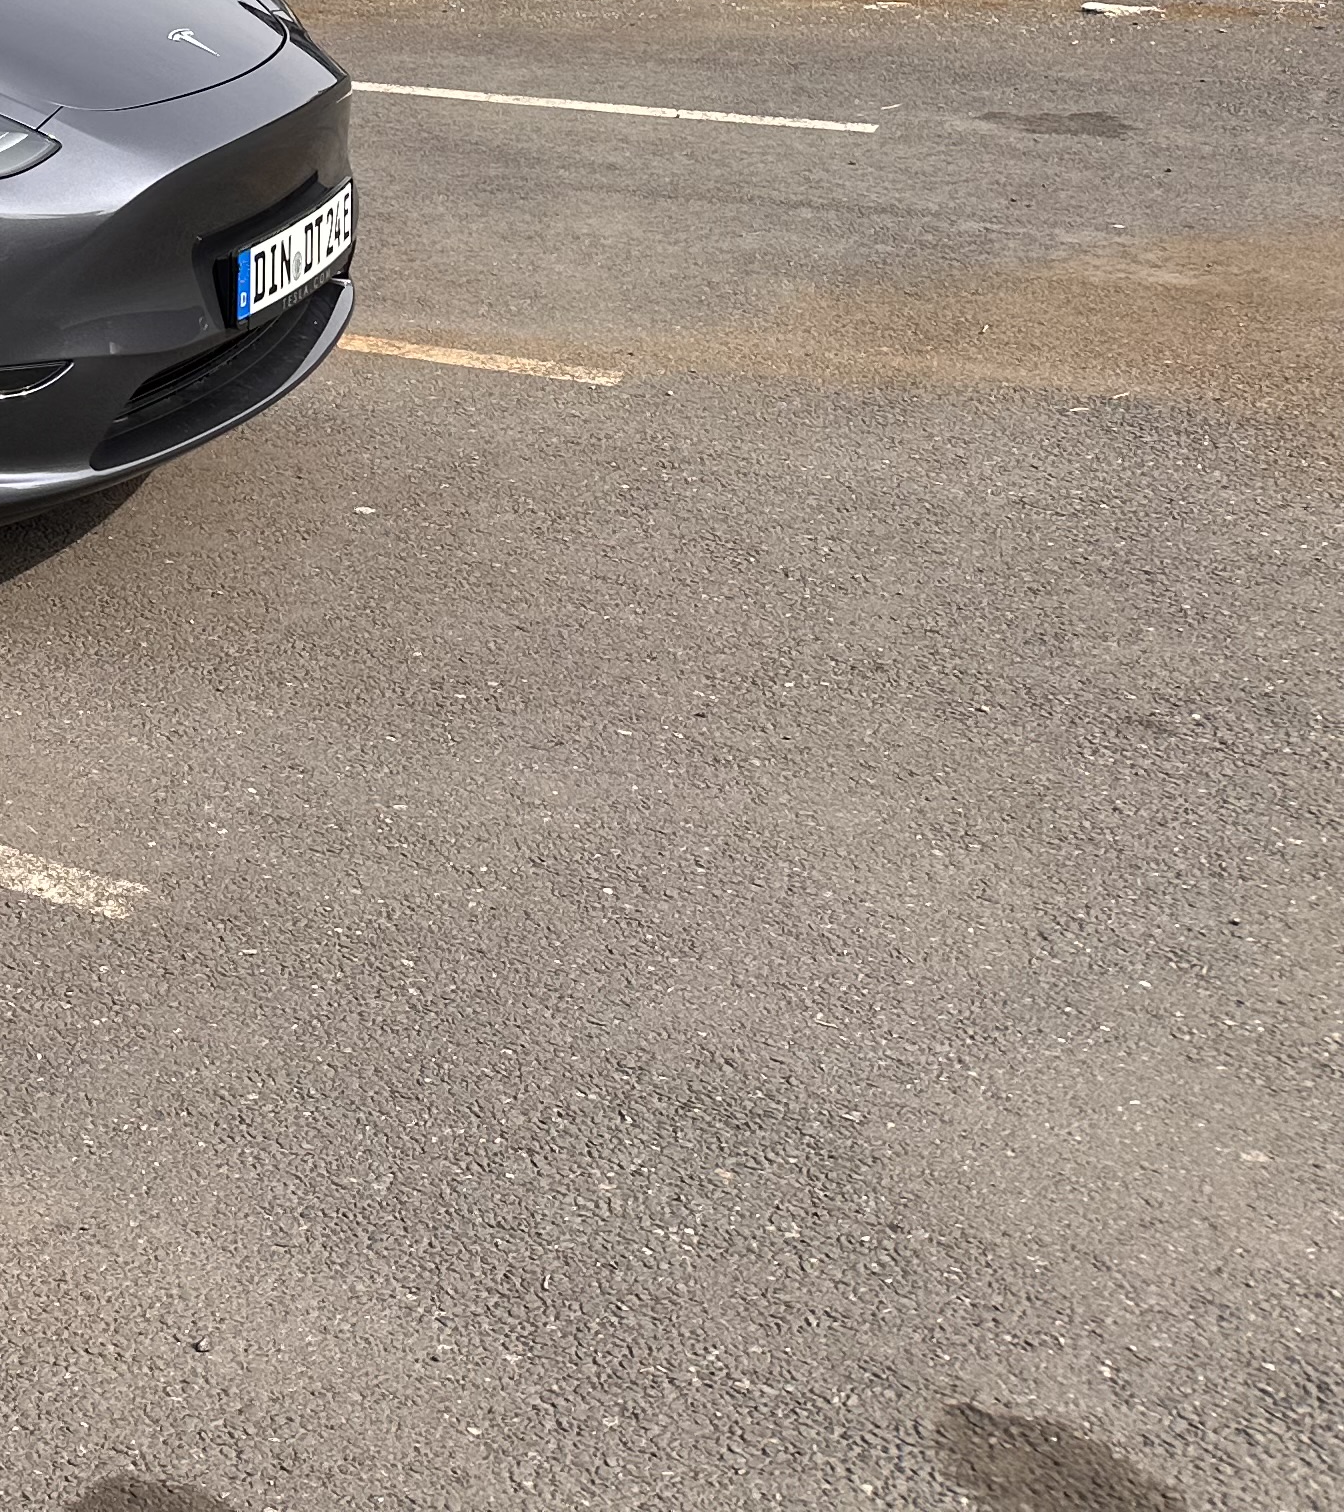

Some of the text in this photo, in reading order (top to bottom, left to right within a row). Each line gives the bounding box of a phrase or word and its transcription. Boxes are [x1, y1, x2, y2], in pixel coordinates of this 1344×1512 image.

[253, 235, 292, 305] DIN
[304, 214, 324, 274] DT
[240, 292, 247, 308] D
